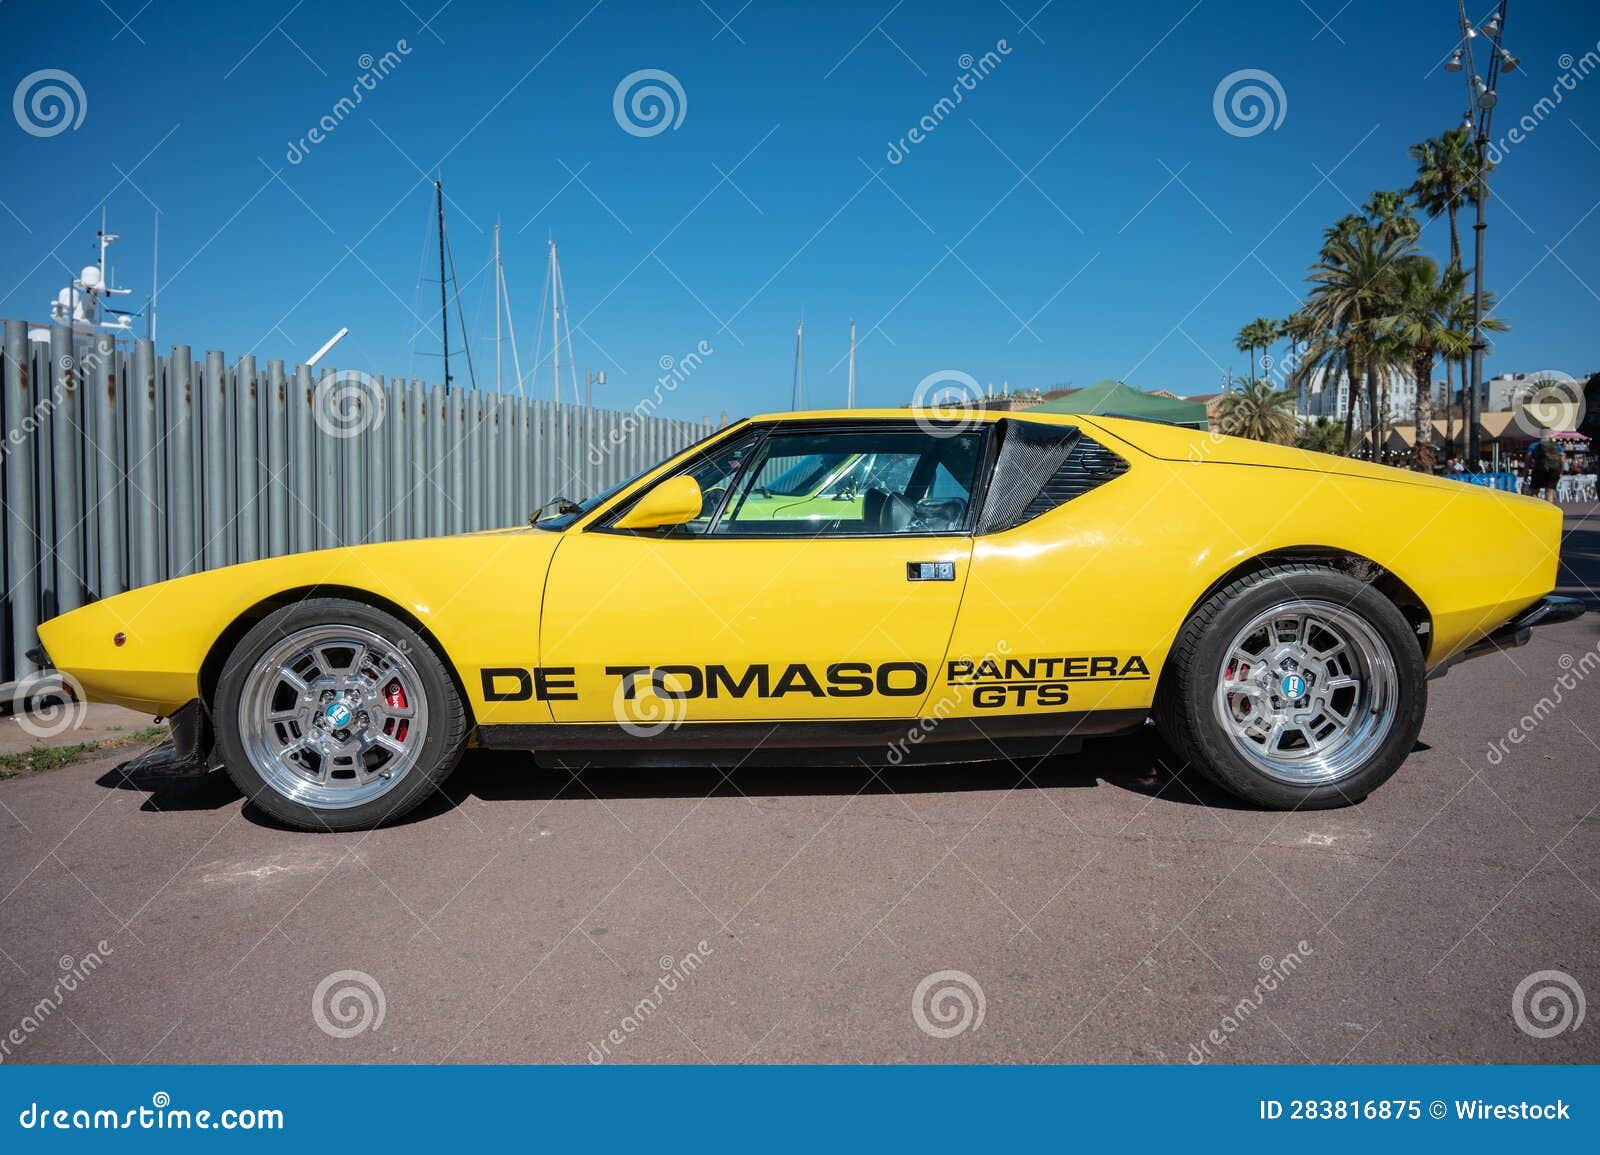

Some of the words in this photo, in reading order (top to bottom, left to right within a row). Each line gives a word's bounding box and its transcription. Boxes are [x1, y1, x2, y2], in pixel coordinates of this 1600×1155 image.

[947, 656, 1151, 681] PANTERA
[480, 667, 578, 702] DE
[605, 662, 928, 700] TOMASO
[972, 684, 1069, 708] GTS
